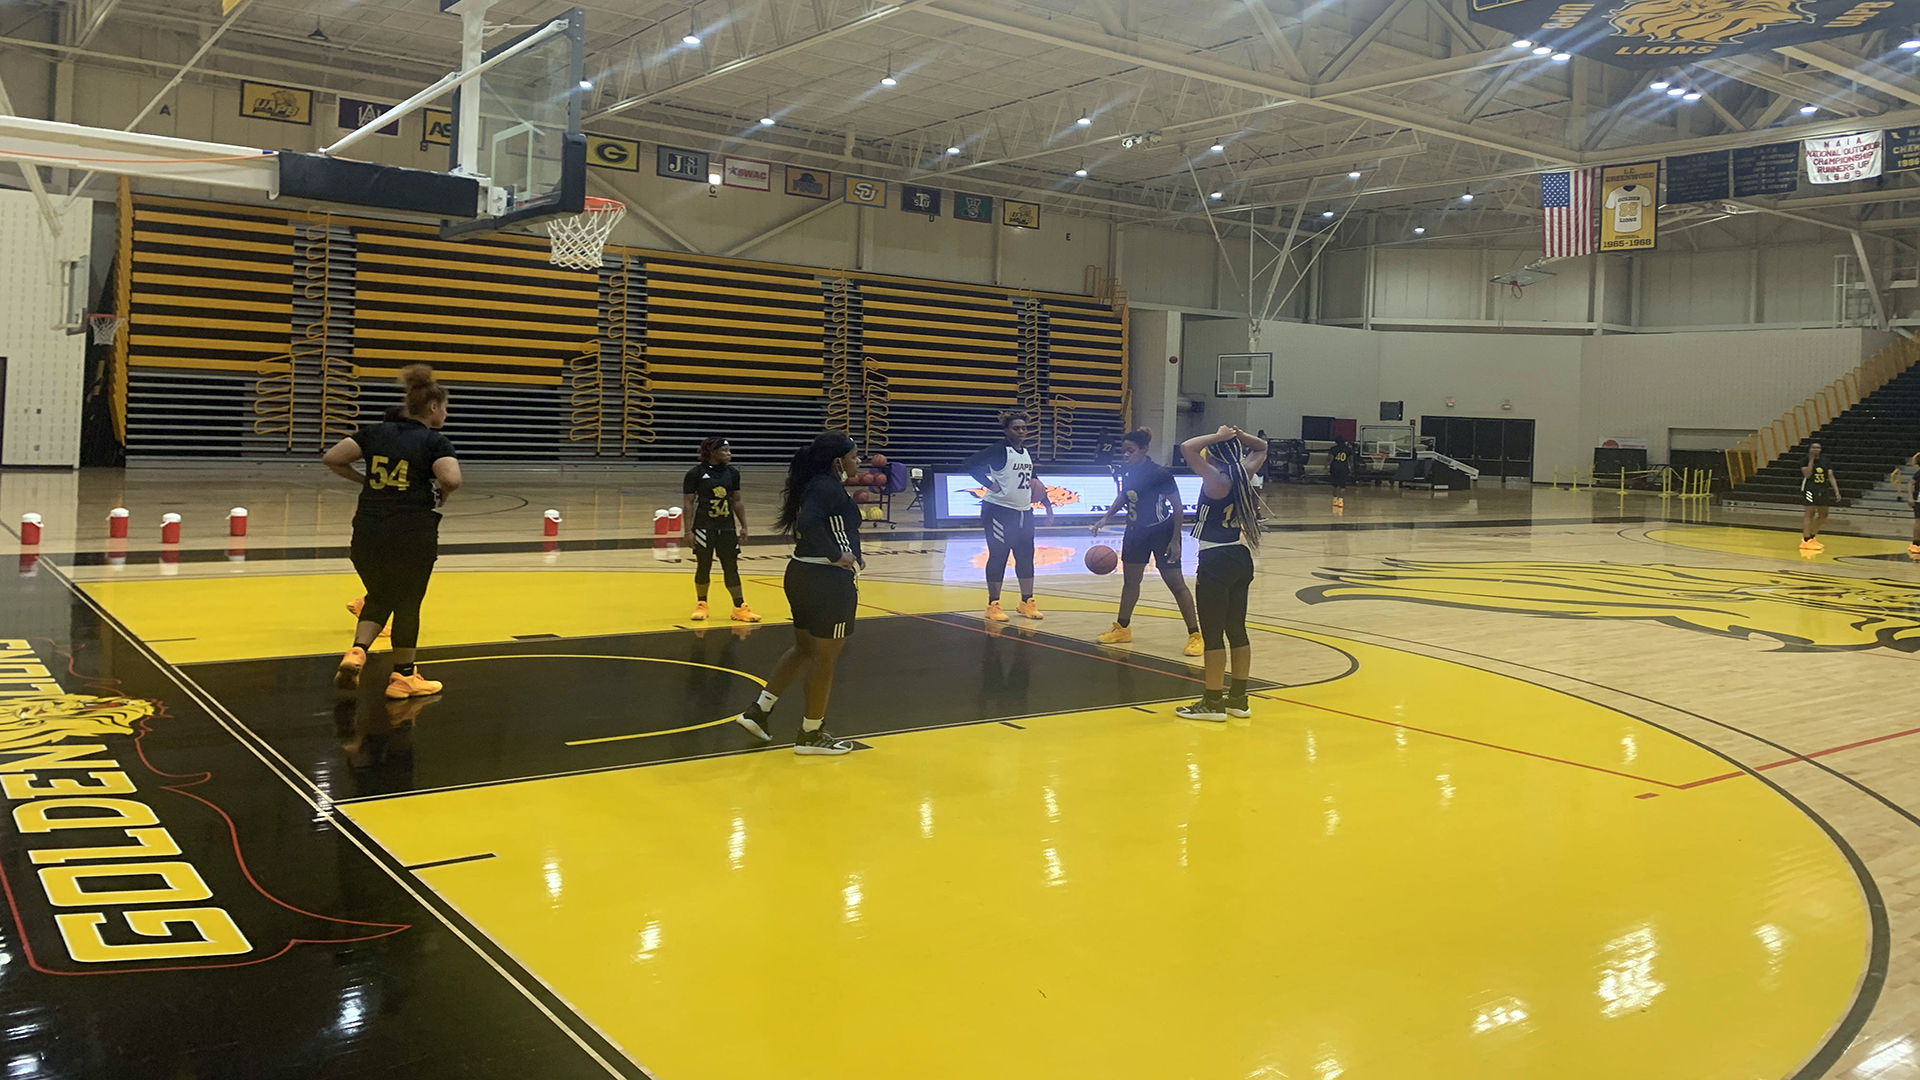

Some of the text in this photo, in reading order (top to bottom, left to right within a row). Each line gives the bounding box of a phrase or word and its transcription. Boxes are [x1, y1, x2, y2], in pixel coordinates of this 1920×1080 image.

[1541, 3, 1595, 29] UAPB
[1823, 1, 1895, 27] UAPB
[1615, 45, 1718, 55] LIONS
[159, 104, 171, 116] A
[253, 97, 300, 117] UAPB
[596, 142, 629, 163] G
[1806, 141, 1881, 158] NATIONAL OUTDOOR
[1812, 151, 1874, 166] CHAMPIONSHIP
[1817, 160, 1870, 174] RUNNERS UP
[737, 168, 767, 180] SWAC
[709, 184, 717, 195] C
[854, 182, 878, 202] SU
[1619, 202, 1638, 217] 88
[1335, 451, 1347, 462] 40
[369, 455, 410, 491] 54
[1017, 472, 1031, 490] 25
[1814, 473, 1825, 484] 33
[708, 499, 730, 518] 34
[0, 743, 254, 963] GOLDEN
